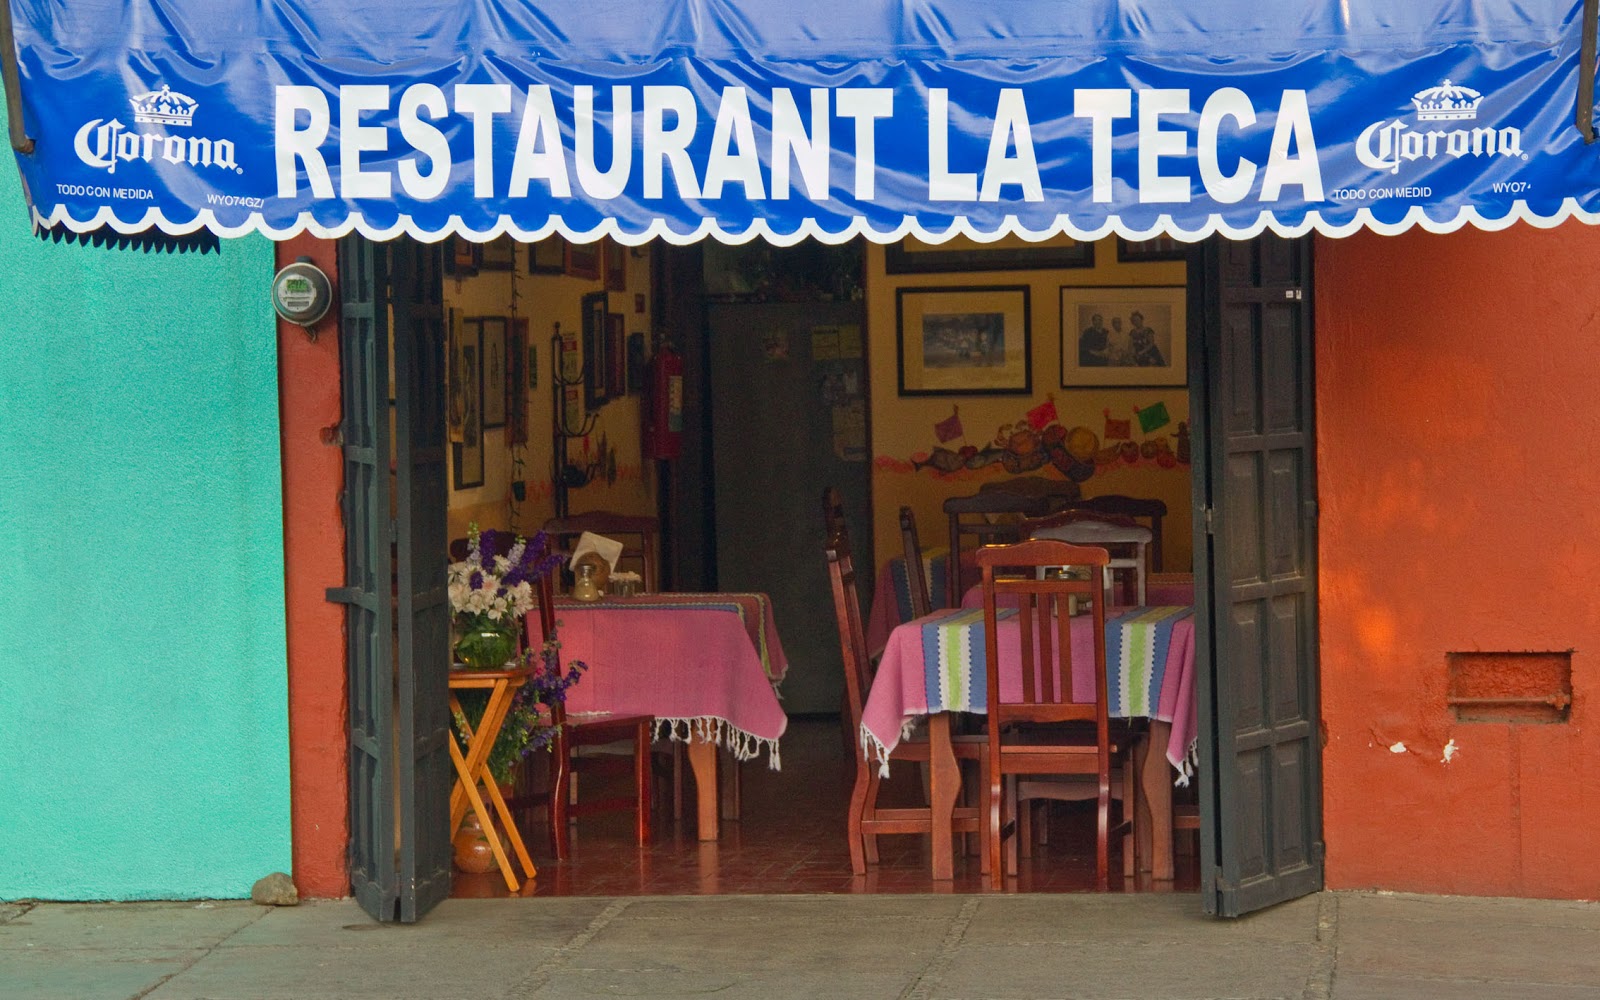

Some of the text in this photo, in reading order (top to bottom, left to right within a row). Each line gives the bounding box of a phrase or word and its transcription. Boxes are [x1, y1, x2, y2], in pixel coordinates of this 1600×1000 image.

[74, 118, 239, 174] Corona
[275, 83, 1325, 204] RESTAURANT LA TECA
[1355, 118, 1524, 175] Corona
[56, 184, 154, 200] TODO CON MEDIDA
[1334, 187, 1432, 200] TODO CON MEDID
